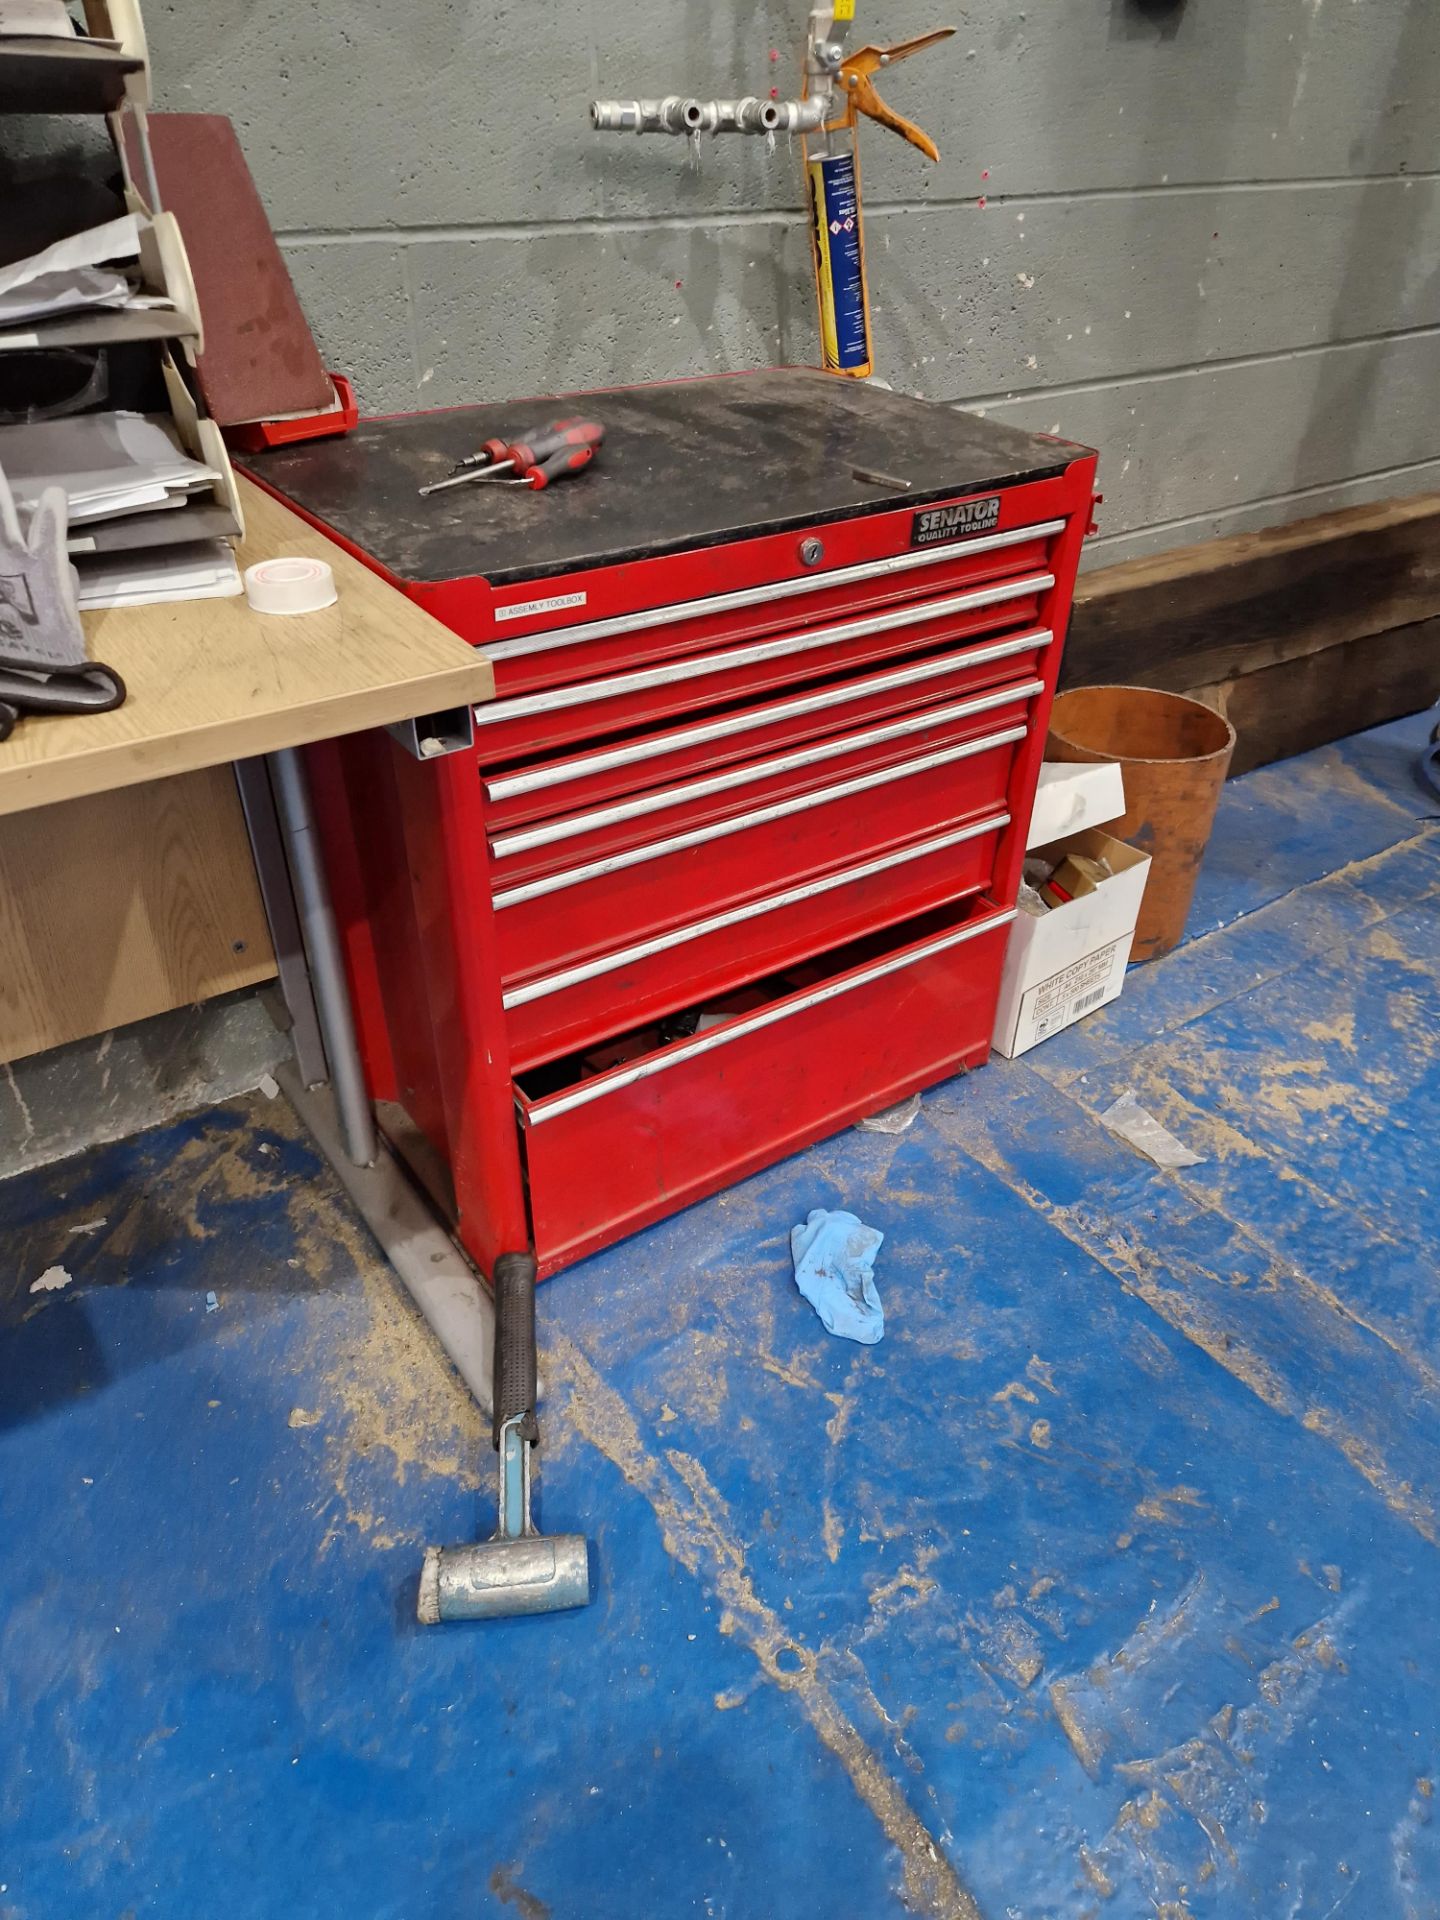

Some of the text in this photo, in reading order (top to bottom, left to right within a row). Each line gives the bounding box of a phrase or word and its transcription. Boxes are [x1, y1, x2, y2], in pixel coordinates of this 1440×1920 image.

[918, 517, 998, 542] QUALITY TOOLING
[920, 498, 1000, 532] SENATOR
[508, 603, 544, 615] ASSEMLY
[546, 595, 583, 608] TOOLBOX
[1038, 944, 1117, 995] WHITE COPY PAPER
